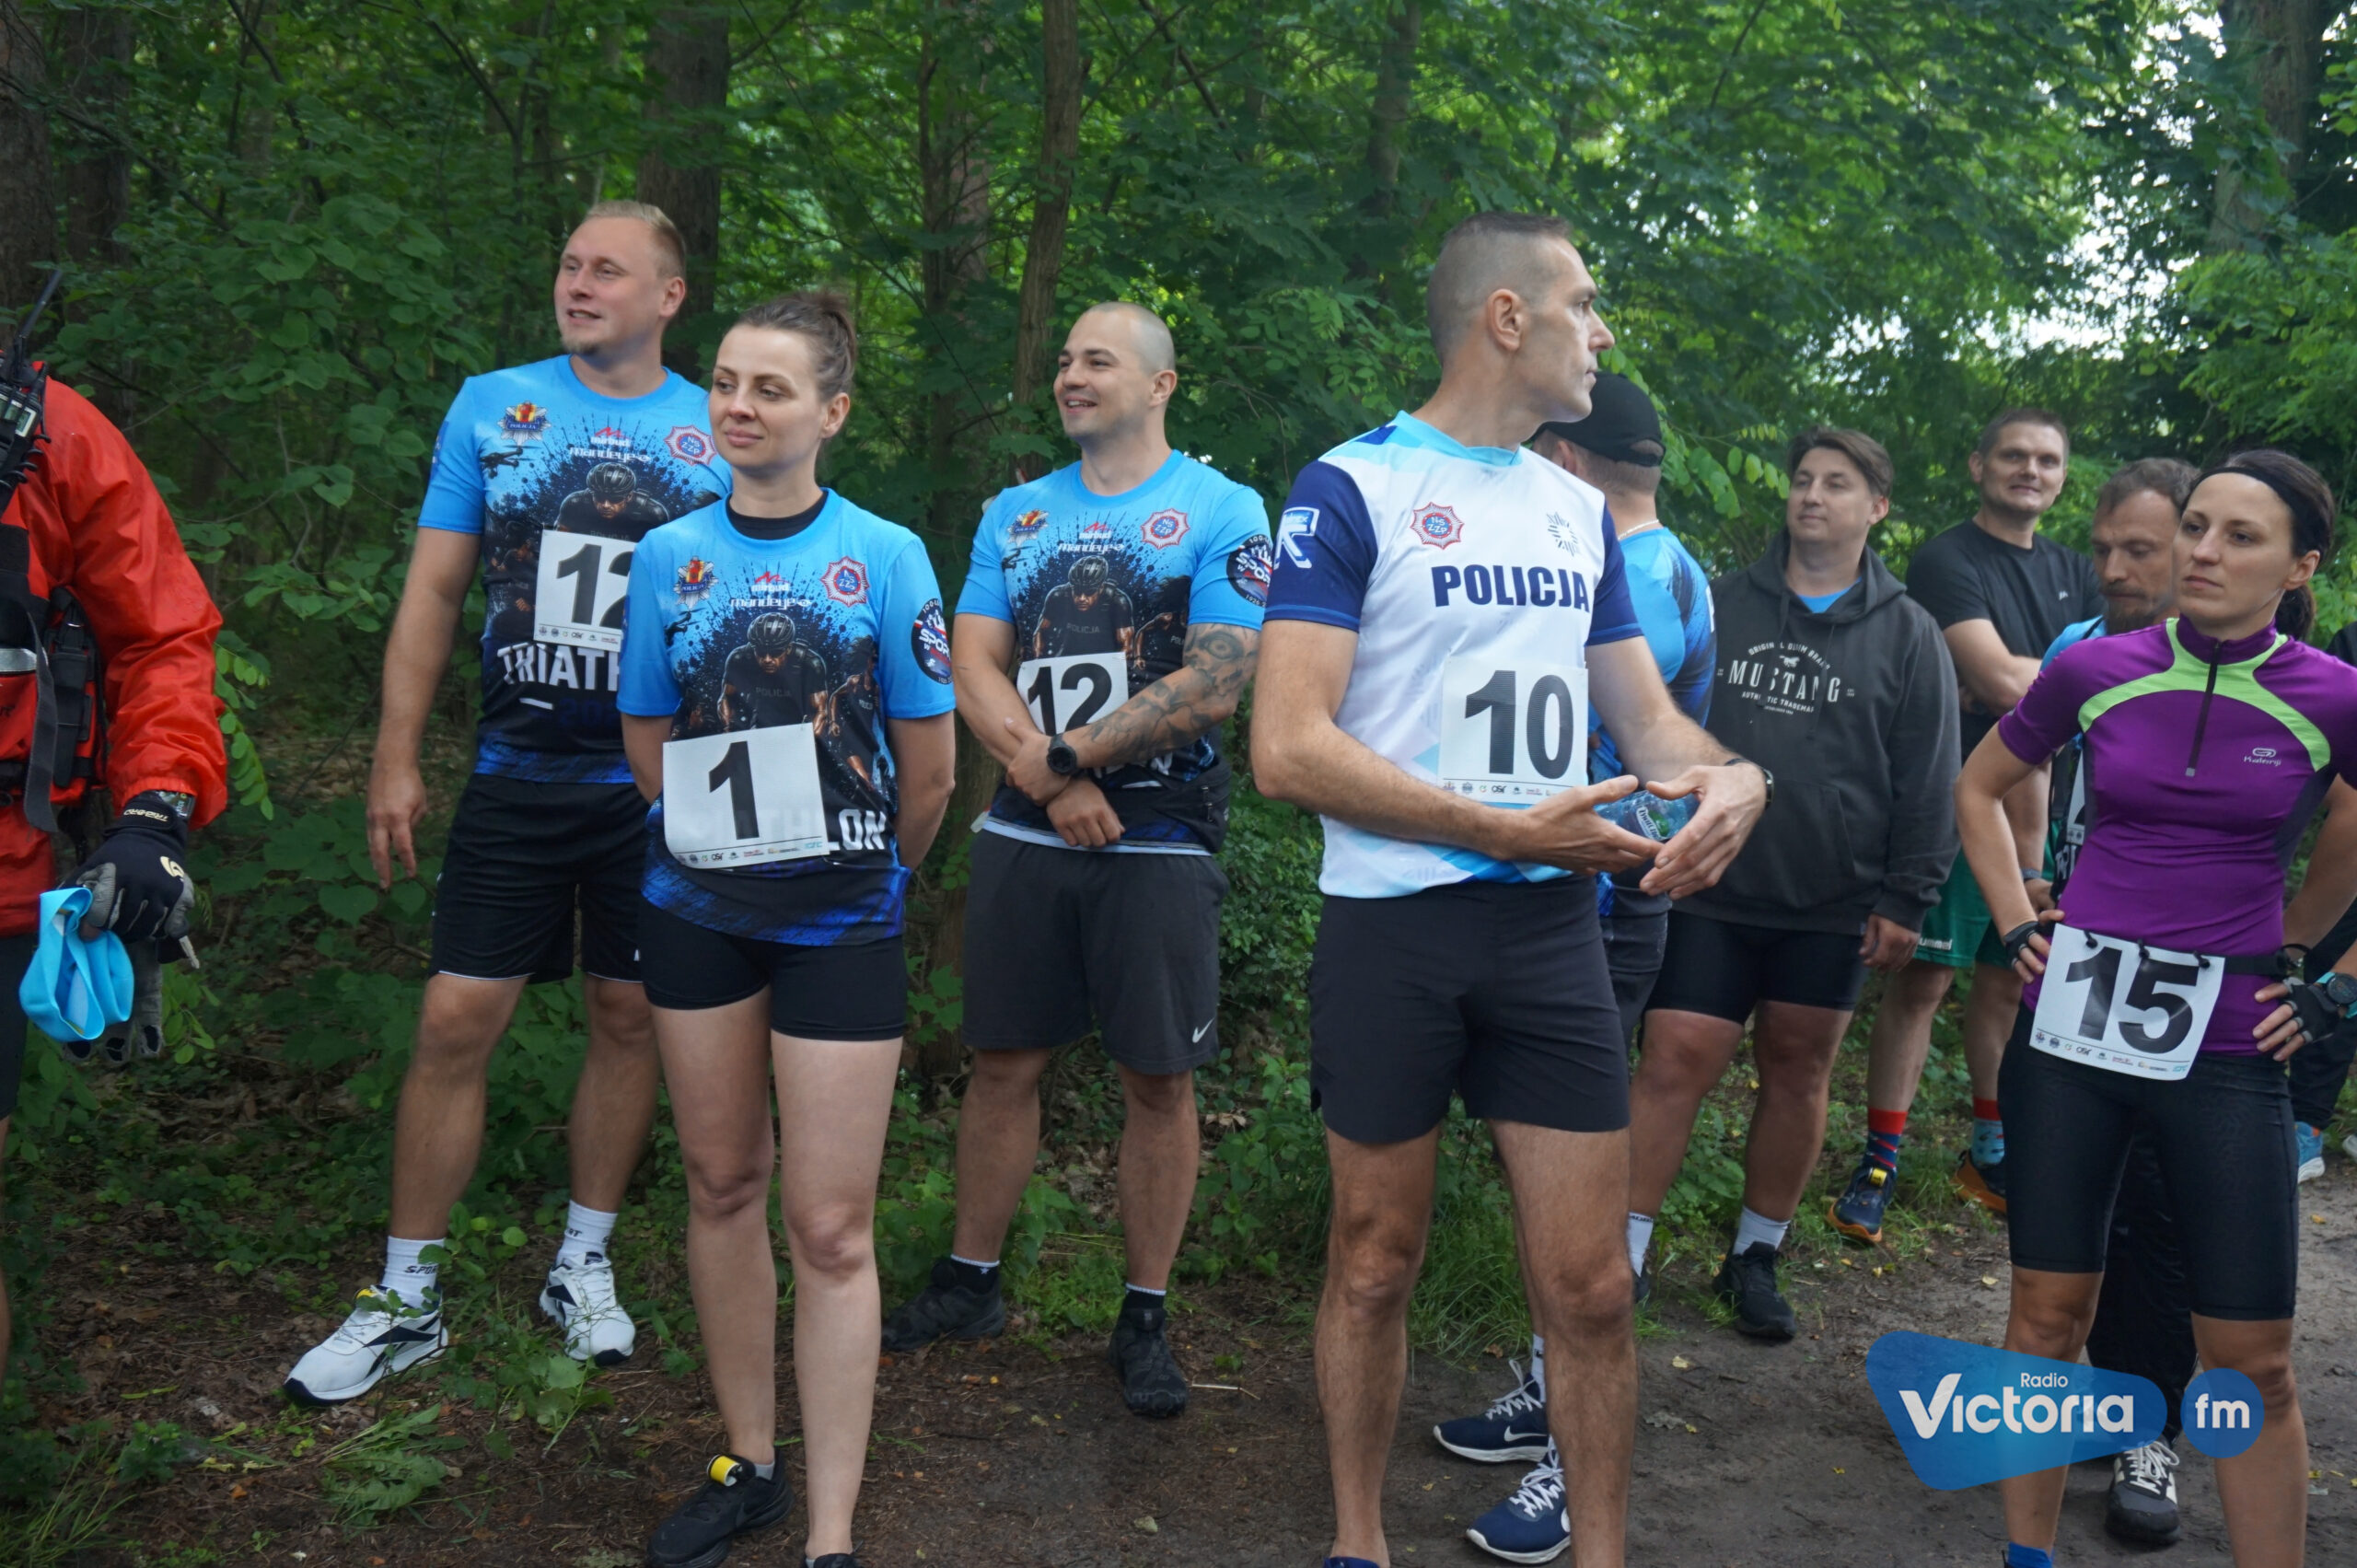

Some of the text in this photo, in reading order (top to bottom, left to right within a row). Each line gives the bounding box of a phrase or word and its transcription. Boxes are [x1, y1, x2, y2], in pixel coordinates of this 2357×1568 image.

[1430, 563, 1590, 613] POLICJA
[1747, 642, 1785, 656] ORIGINL
[1027, 662, 1112, 737] 12
[1465, 669, 1573, 780] 10
[1741, 691, 1779, 704] AUTHTIC
[709, 740, 760, 840] 1
[1918, 936, 1953, 951] ummel
[2065, 946, 2200, 1053] 15
